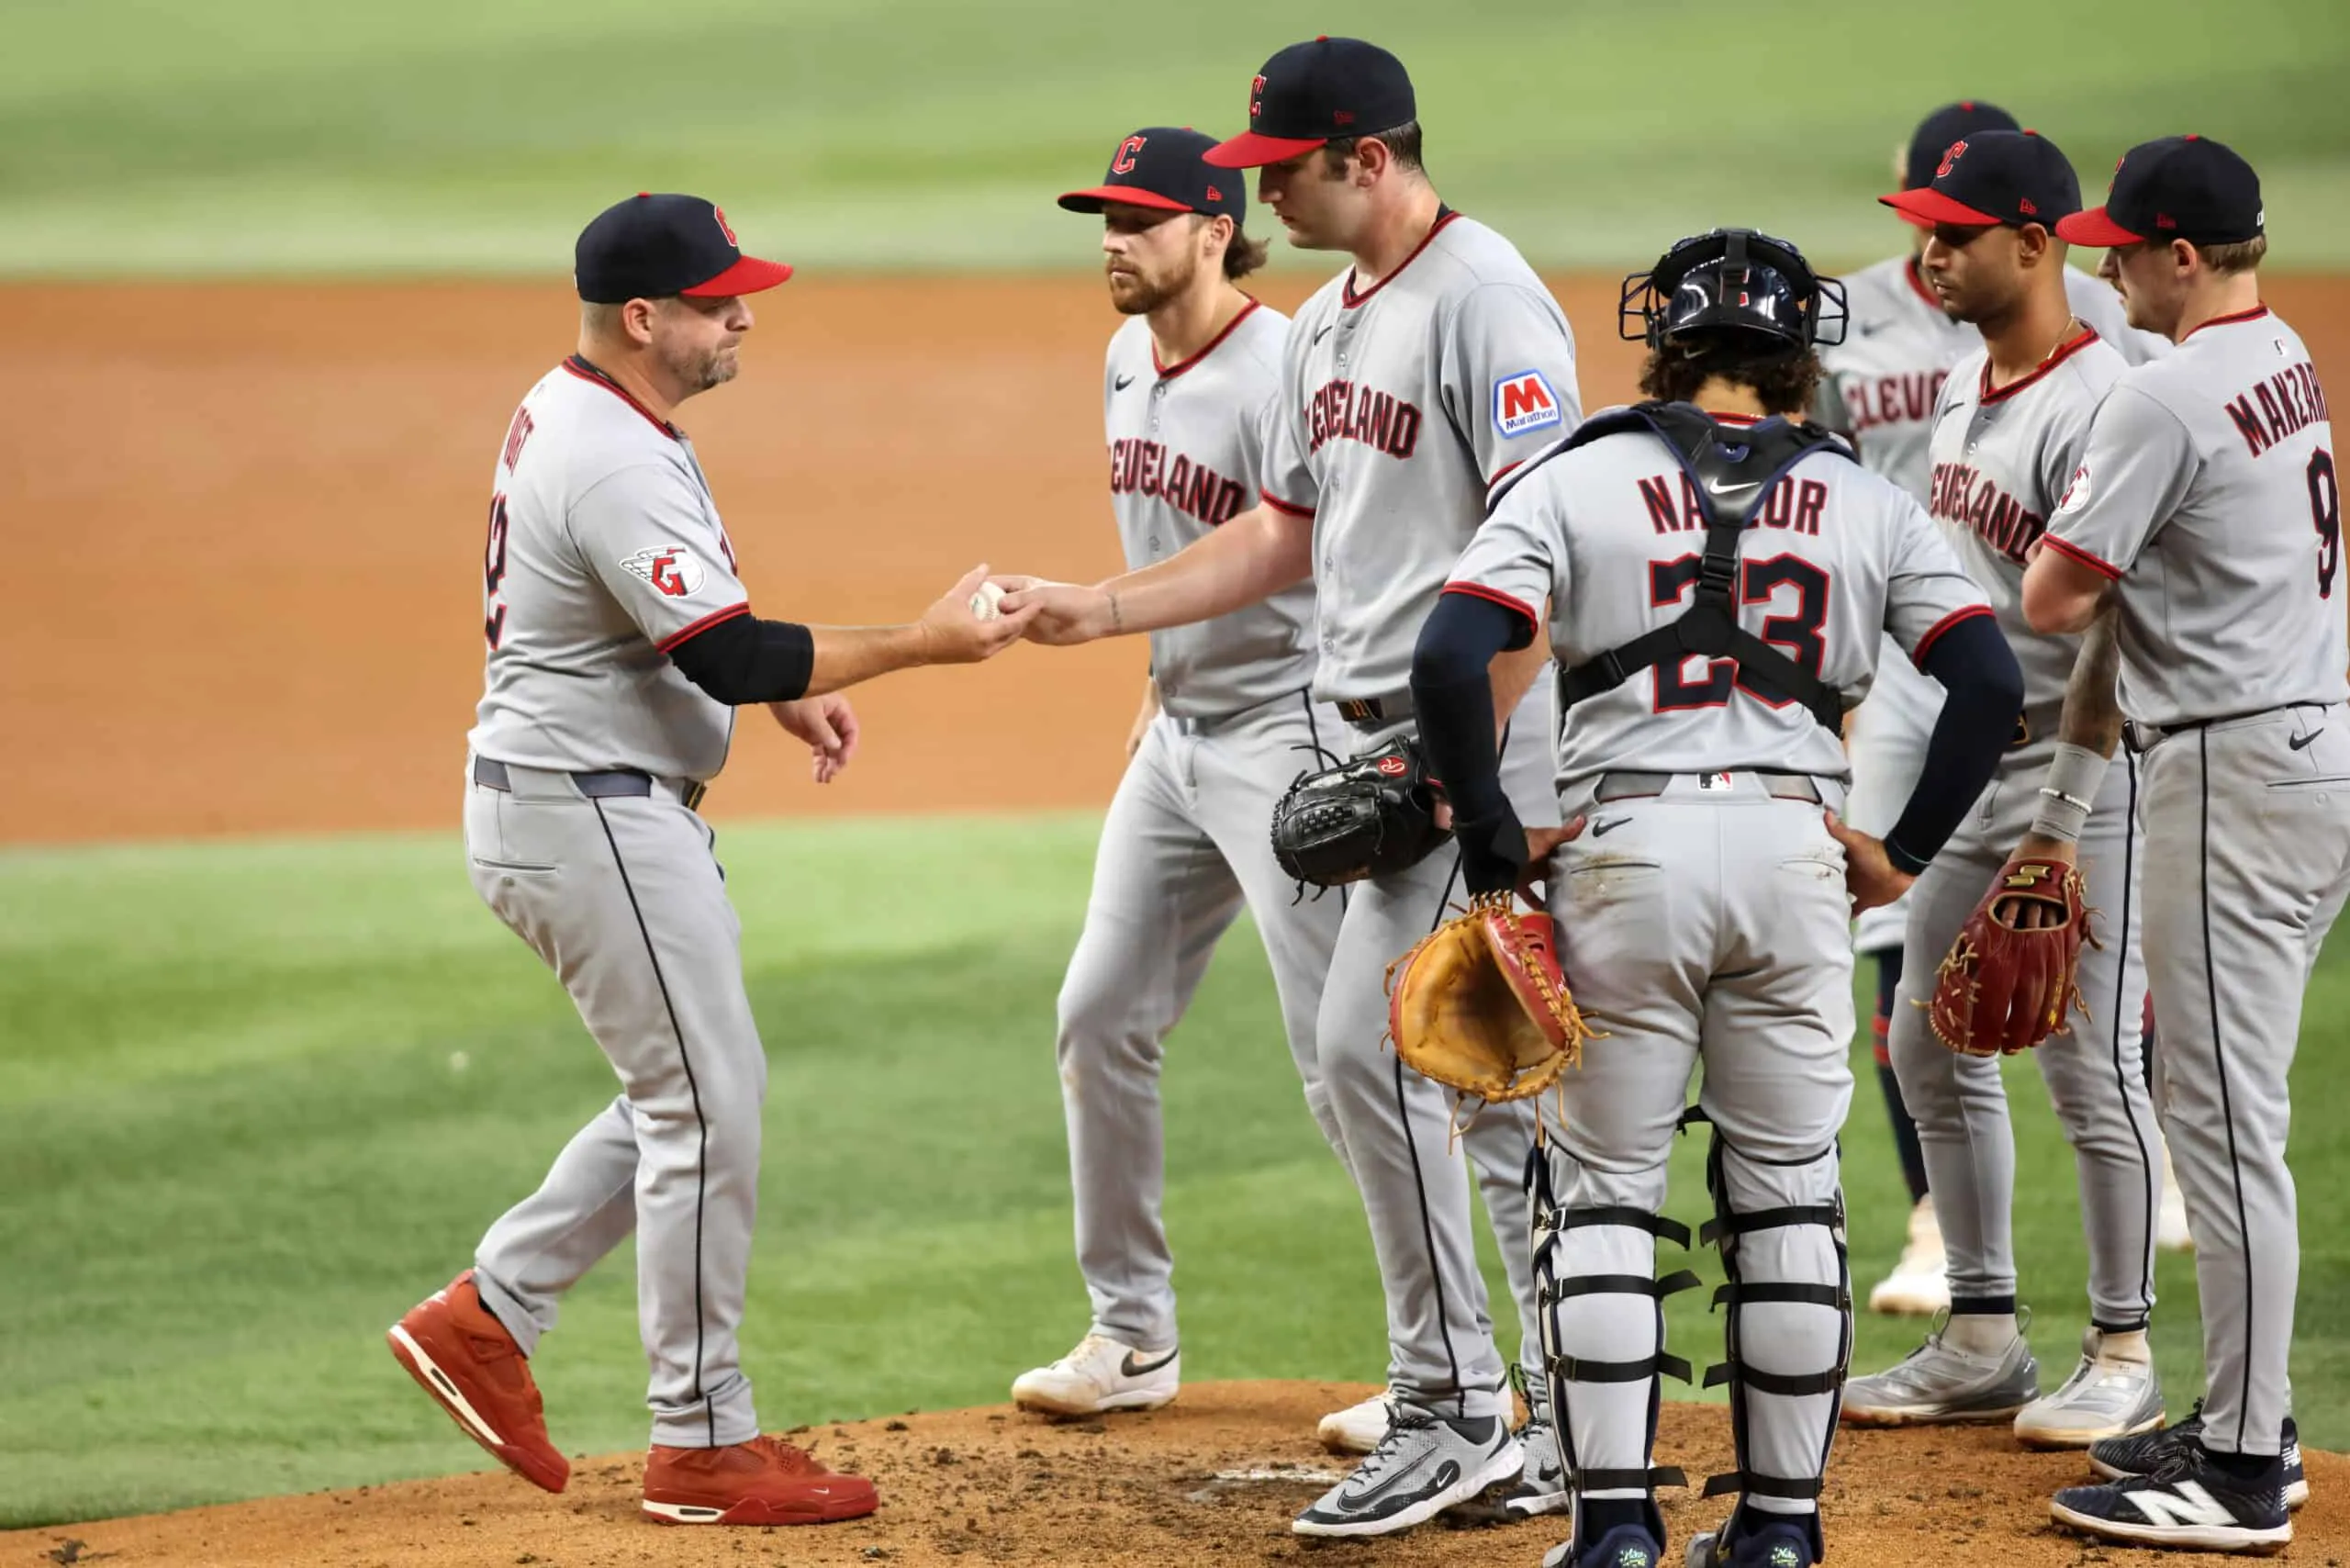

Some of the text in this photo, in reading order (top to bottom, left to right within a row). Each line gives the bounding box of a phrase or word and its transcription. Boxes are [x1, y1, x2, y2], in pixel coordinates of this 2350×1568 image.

[1113, 136, 1147, 174] C
[1937, 140, 1968, 178] C
[1504, 377, 1551, 419] M
[1505, 409, 1557, 431] Marathon
[2224, 362, 2329, 458] MANZAR
[1637, 471, 1828, 536] NAOR
[2306, 445, 2338, 599] 9
[1649, 552, 1830, 713] 23
